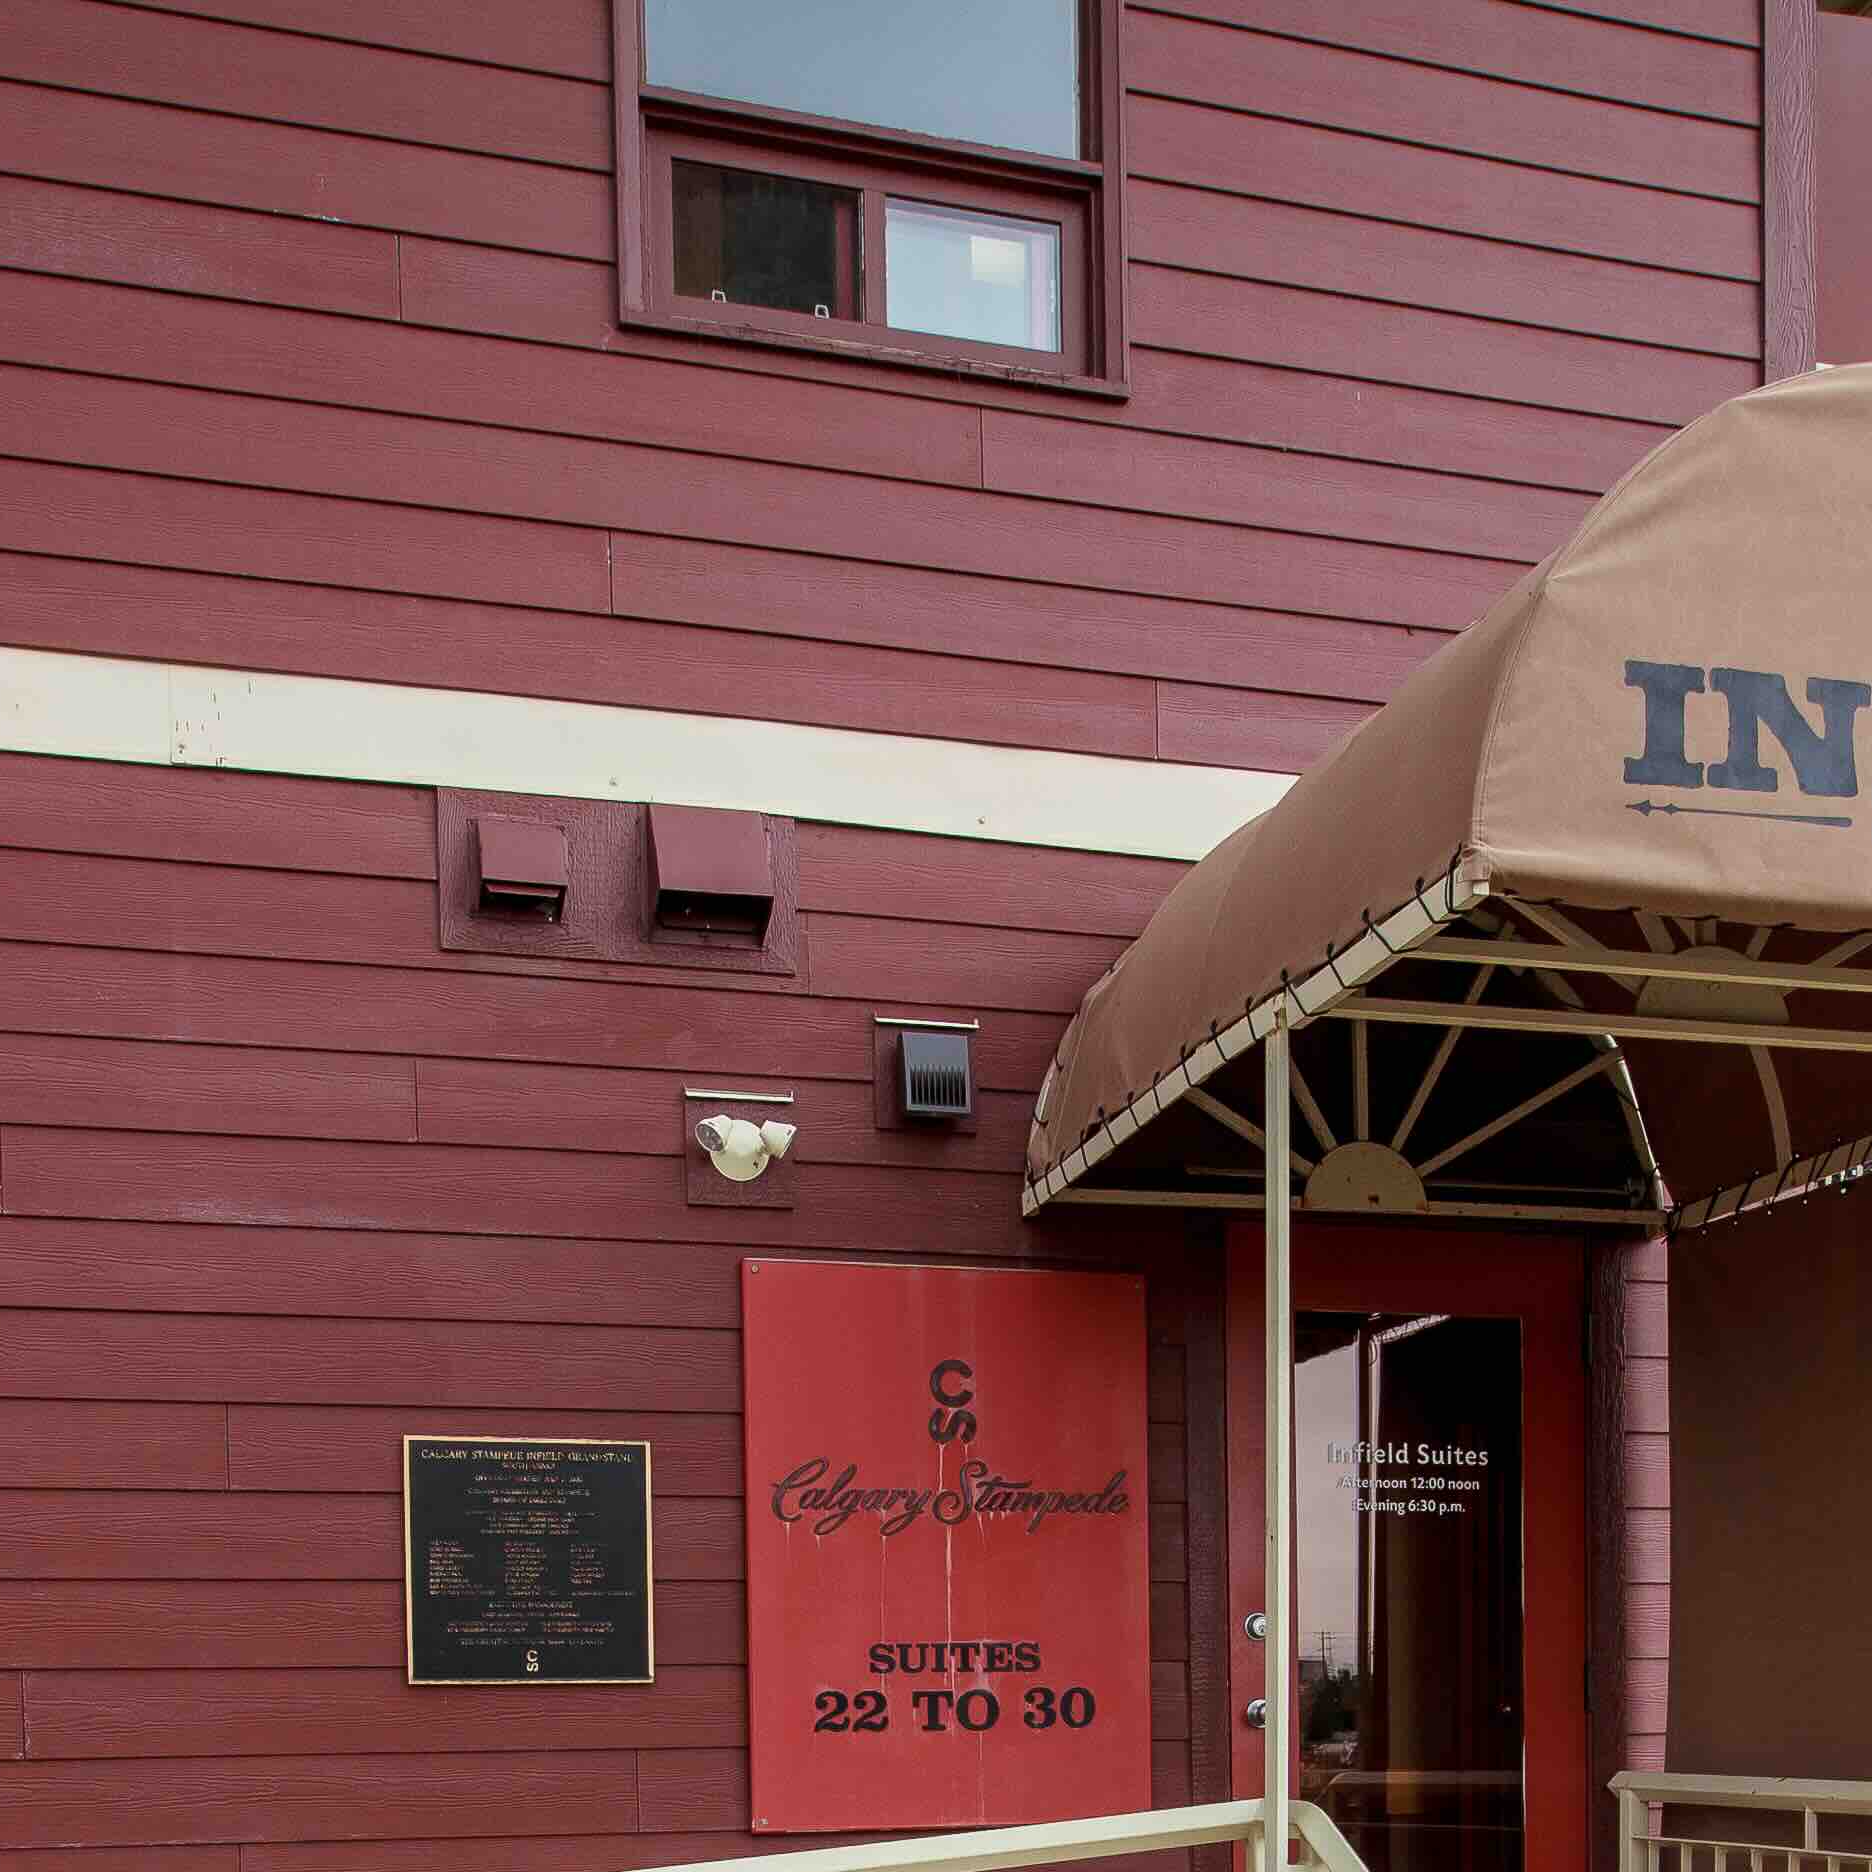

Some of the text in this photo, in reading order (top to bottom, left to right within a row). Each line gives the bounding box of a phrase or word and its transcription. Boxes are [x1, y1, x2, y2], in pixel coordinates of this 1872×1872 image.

[1332, 1441, 1489, 1466] Infield Suites
[771, 1456, 1130, 1536] Calgary Stampede
[1410, 1476, 1445, 1490] 12:00
[1448, 1478, 1480, 1490] noon
[1356, 1498, 1466, 1516] Evening 6:30 p.m.
[868, 1640, 1041, 1674] SUITES
[814, 1685, 1096, 1733] 22 TO 30
